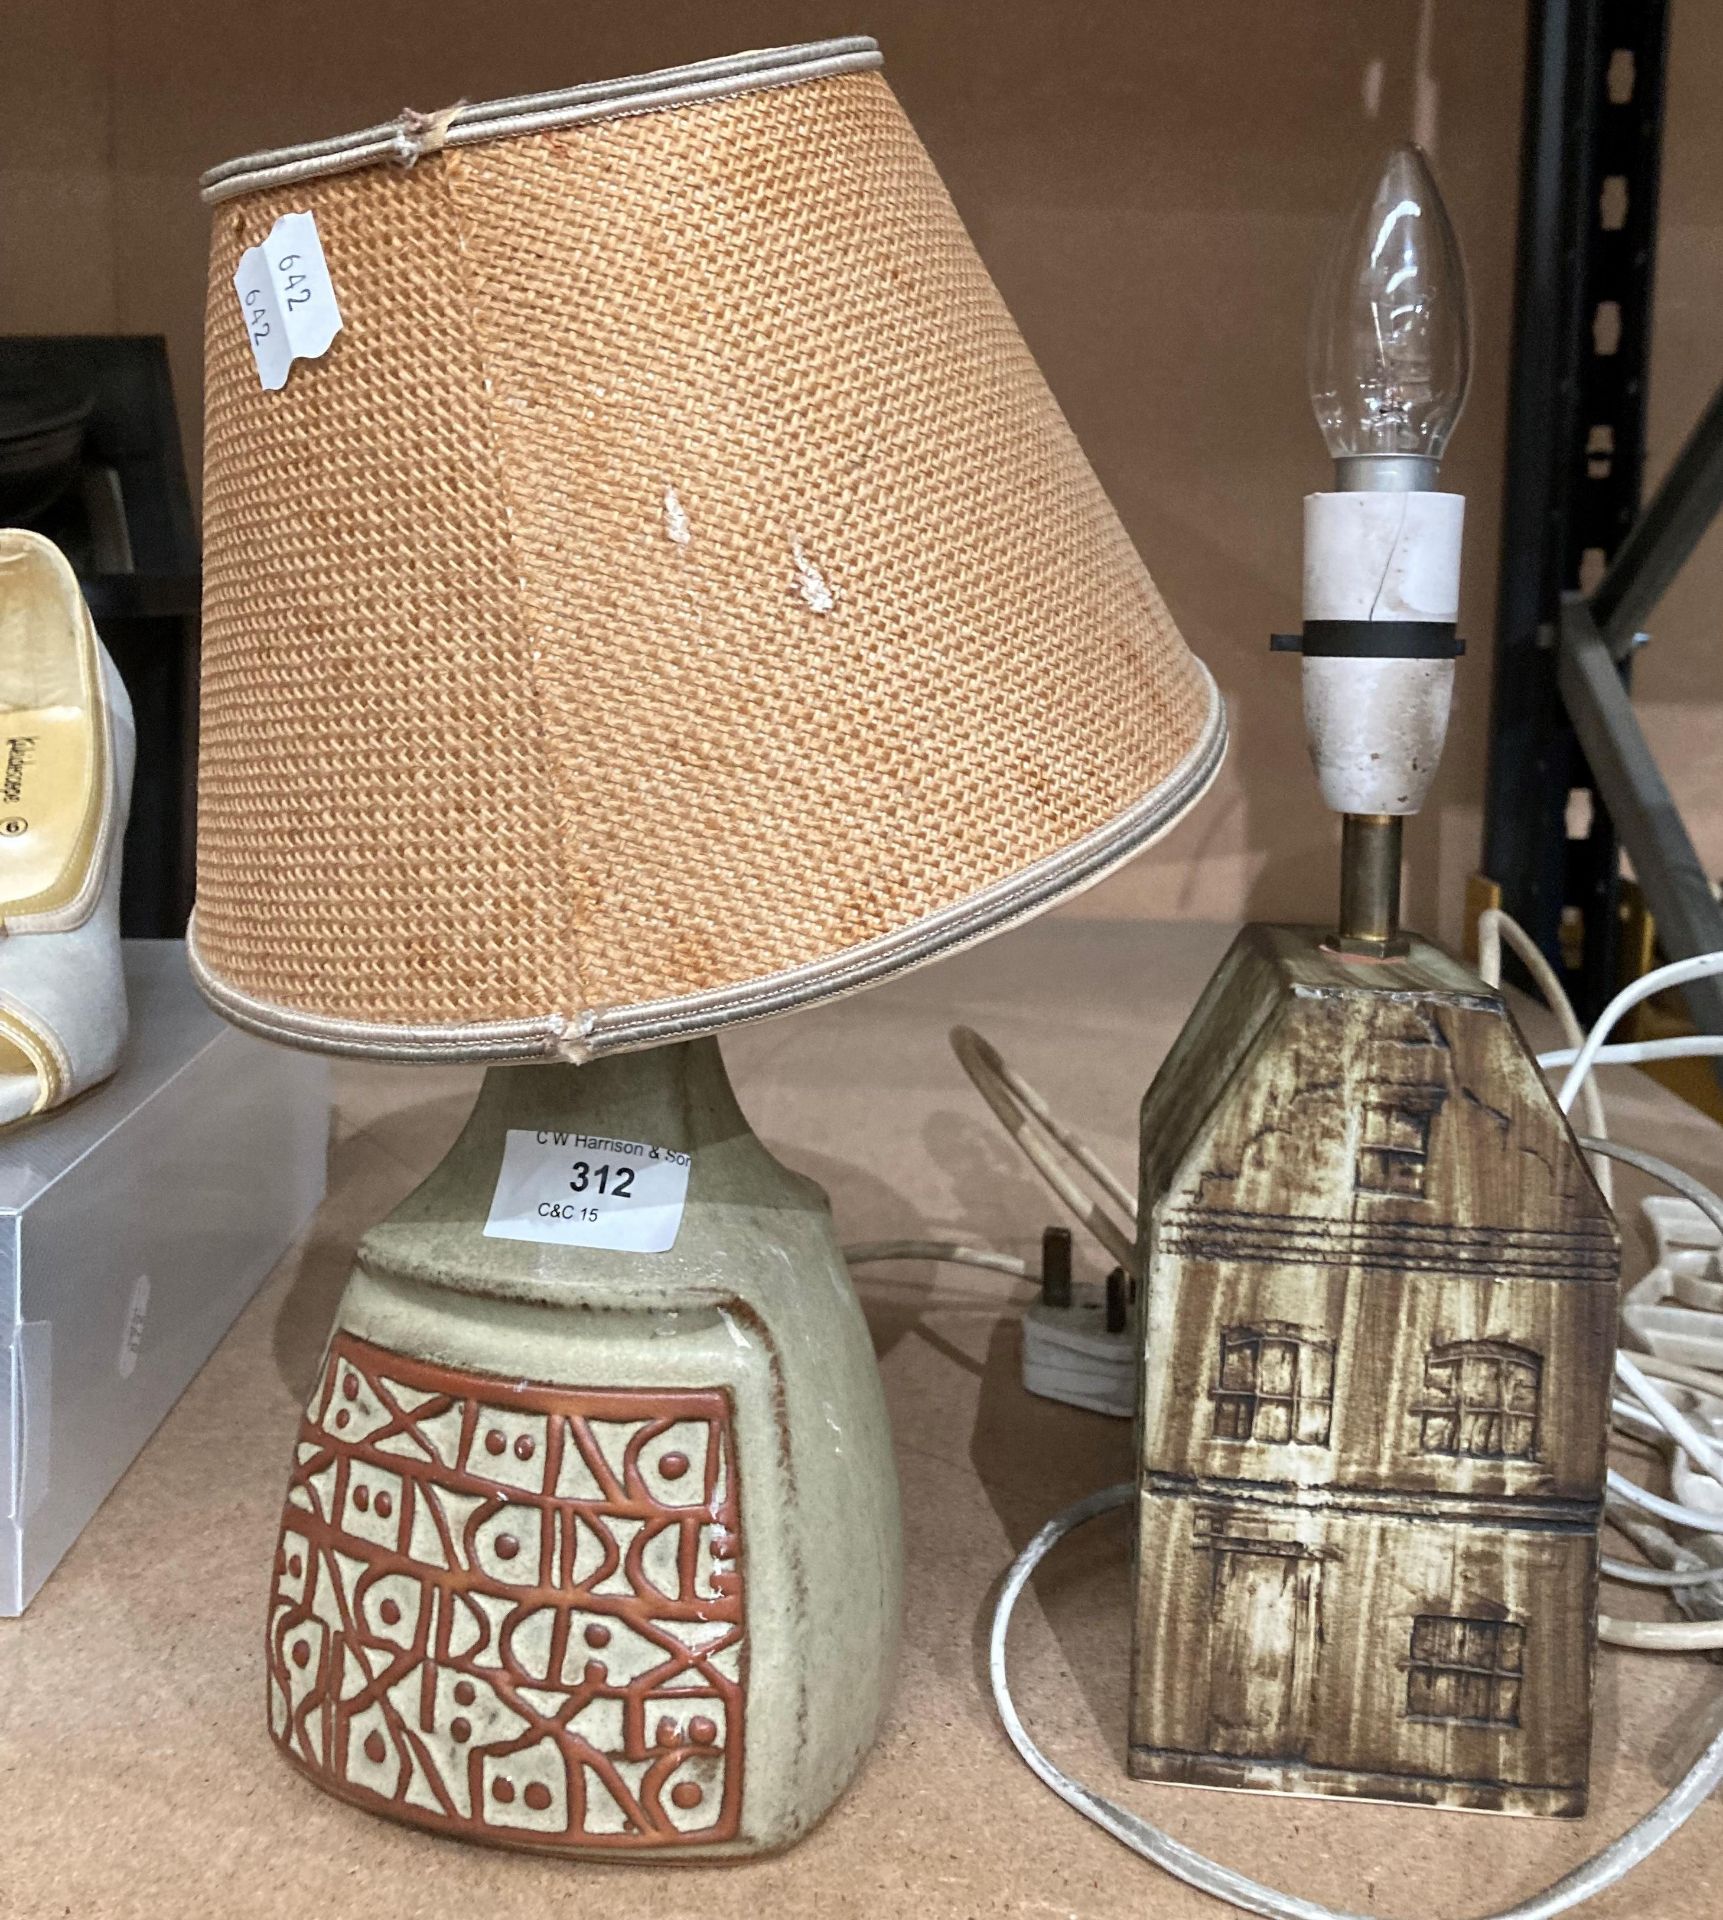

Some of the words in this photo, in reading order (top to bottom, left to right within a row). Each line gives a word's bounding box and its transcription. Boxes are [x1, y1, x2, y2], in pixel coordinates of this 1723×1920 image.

[279, 254, 311, 312] 642
[245, 289, 270, 346] 642
[537, 1131, 548, 1145] C
[552, 1132, 569, 1146] W
[574, 1134, 643, 1156] Harrison
[648, 1147, 660, 1160] &
[570, 1161, 635, 1198] 312
[538, 1202, 574, 1219] C&C
[580, 1208, 599, 1222] 15
